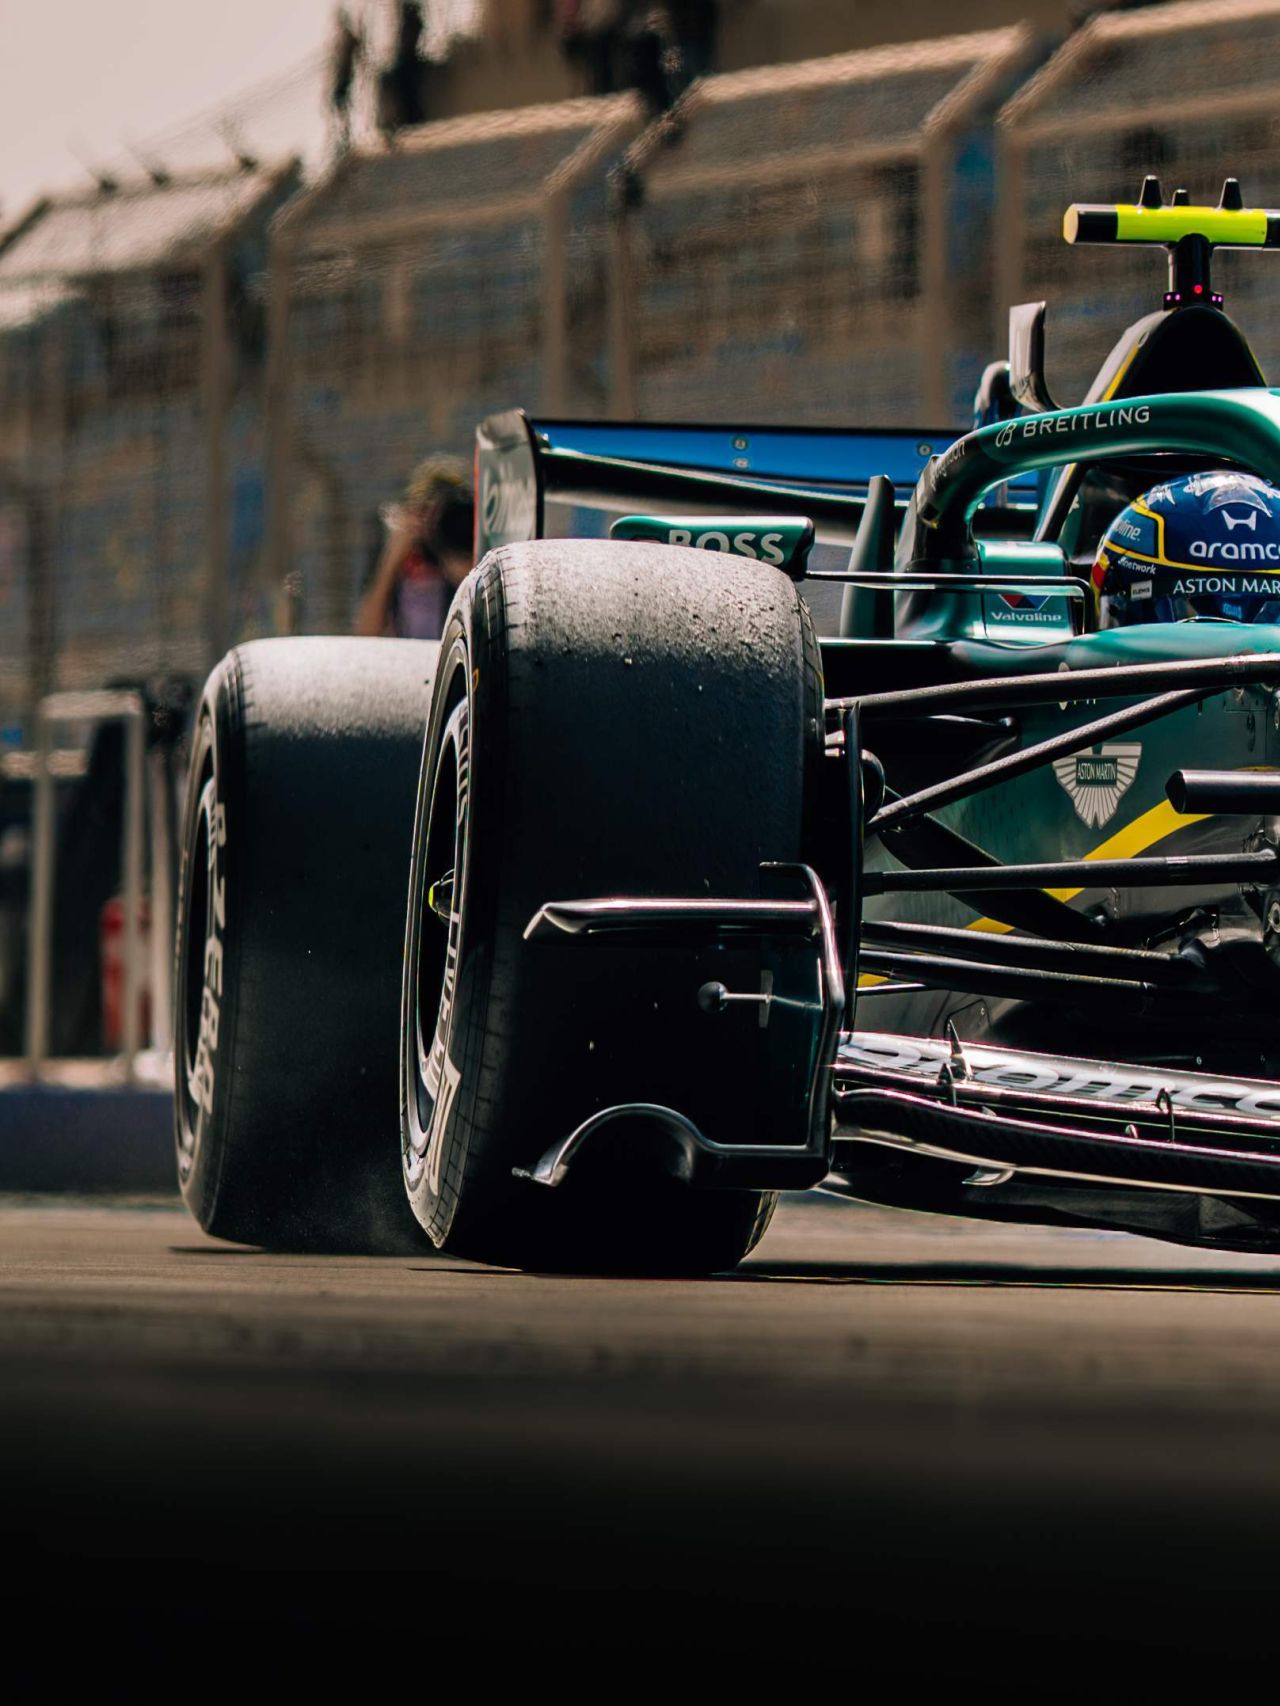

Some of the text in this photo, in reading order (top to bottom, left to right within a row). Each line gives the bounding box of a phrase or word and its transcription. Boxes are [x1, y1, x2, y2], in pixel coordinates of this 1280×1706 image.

[1023, 406, 1150, 437] BREITLING
[668, 529, 784, 566] BOSS
[1173, 577, 1236, 595] ASTON
[991, 612, 1062, 622] Valvoline
[1078, 763, 1116, 780] ASTON MARTIN
